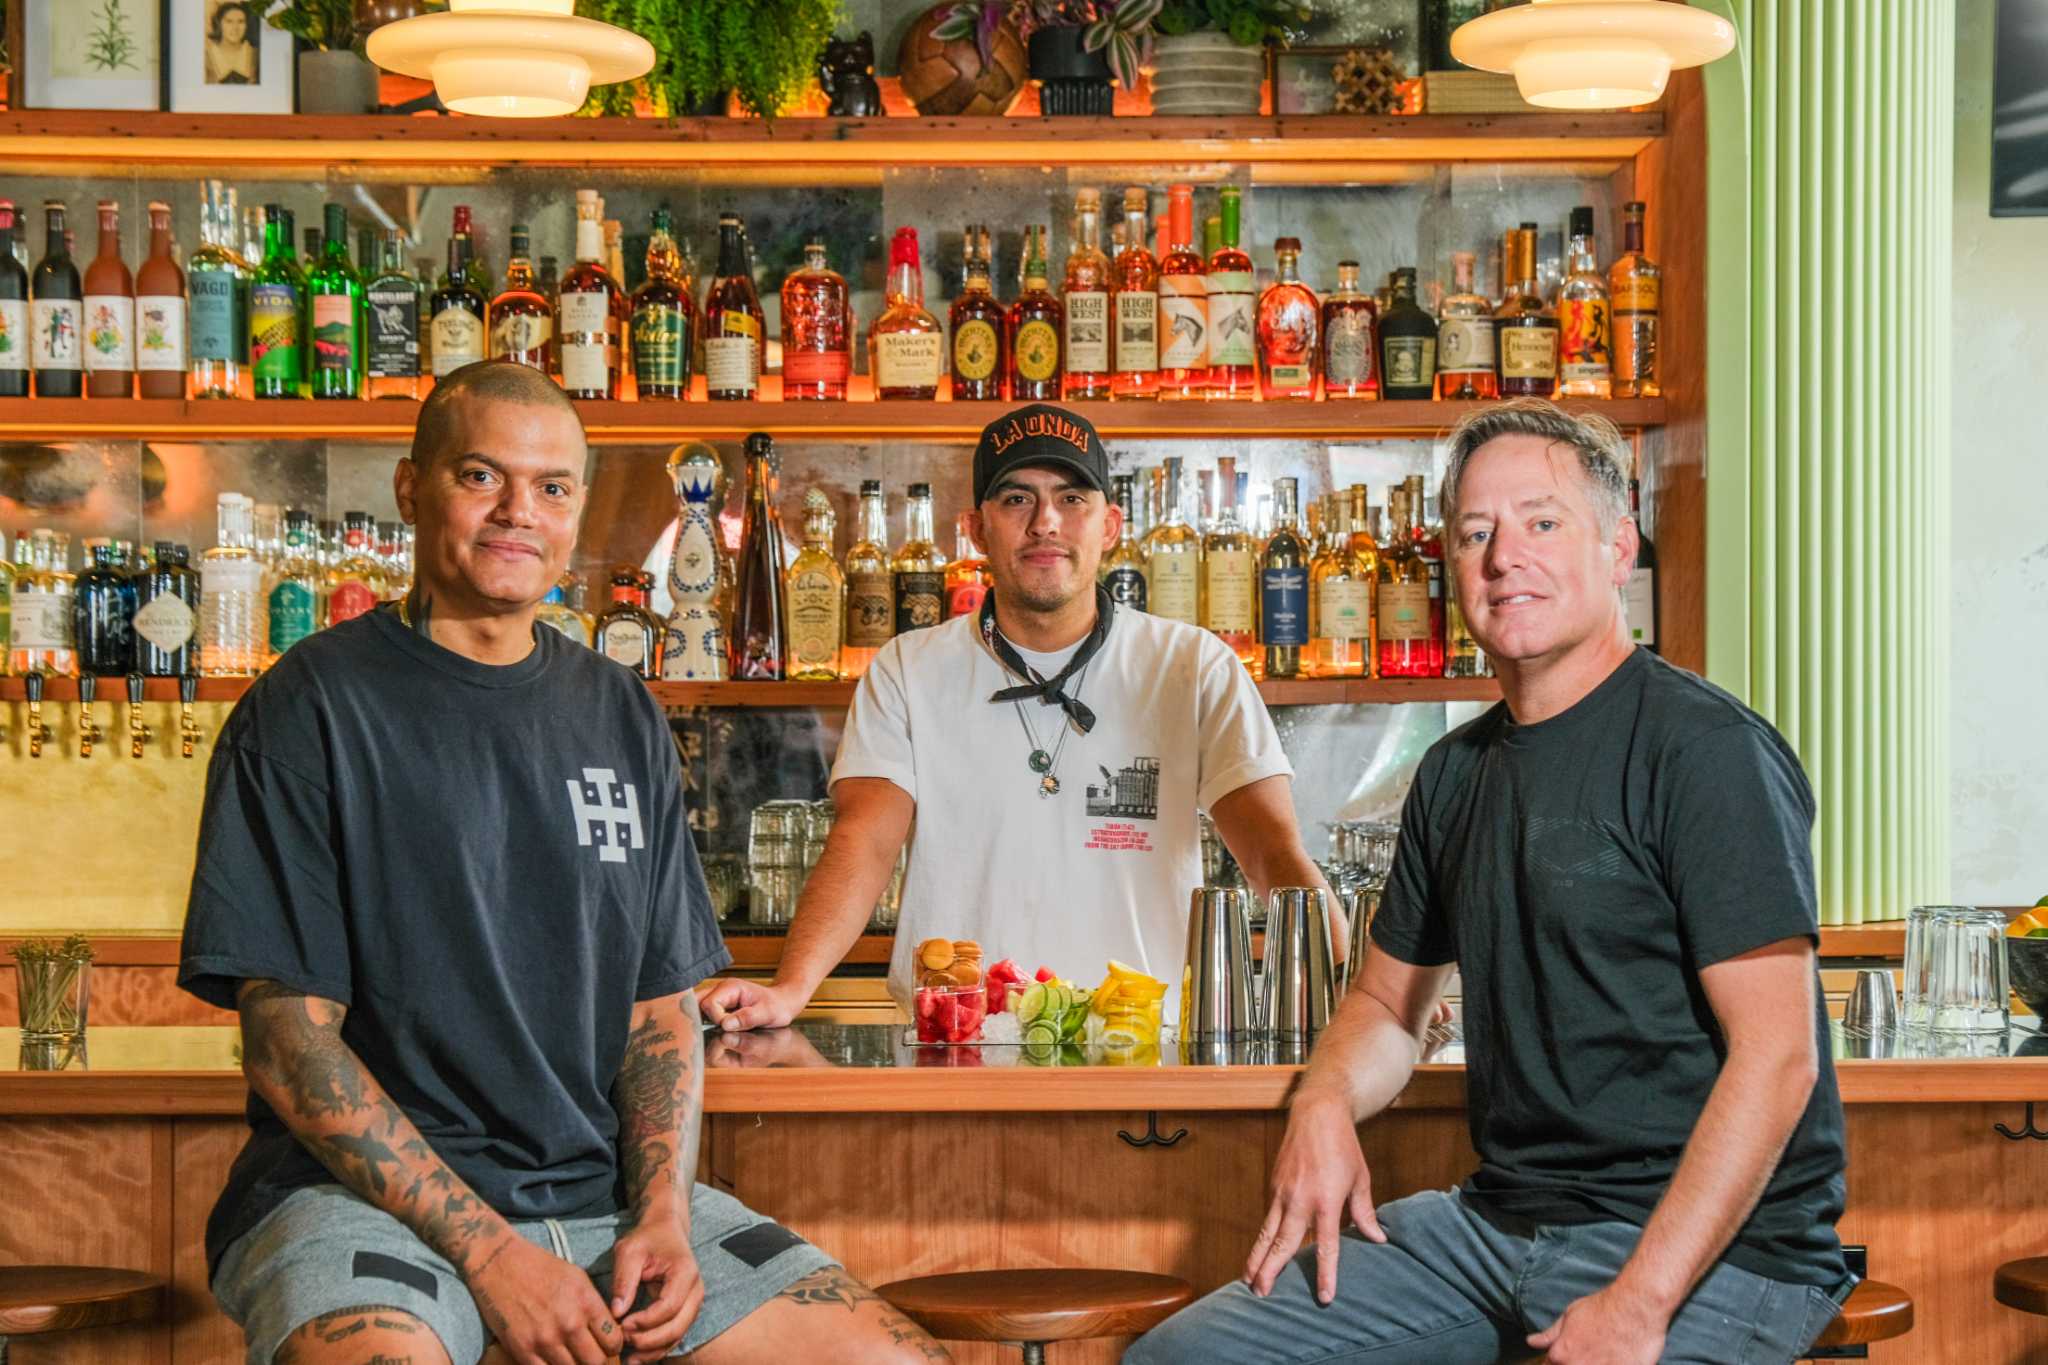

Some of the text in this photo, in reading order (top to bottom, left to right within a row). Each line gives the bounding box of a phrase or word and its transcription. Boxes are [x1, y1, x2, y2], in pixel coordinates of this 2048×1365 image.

[253, 294, 293, 306] VIDA
[1071, 298, 1103, 309] HIGH
[1122, 297, 1153, 309] HIGH
[1071, 310, 1103, 319] WEST
[1122, 310, 1153, 319] WEST
[885, 336, 936, 347] Maker's
[900, 348, 934, 358] Mark
[990, 413, 1089, 455] LA ONDA
[1112, 584, 1140, 602] G4
